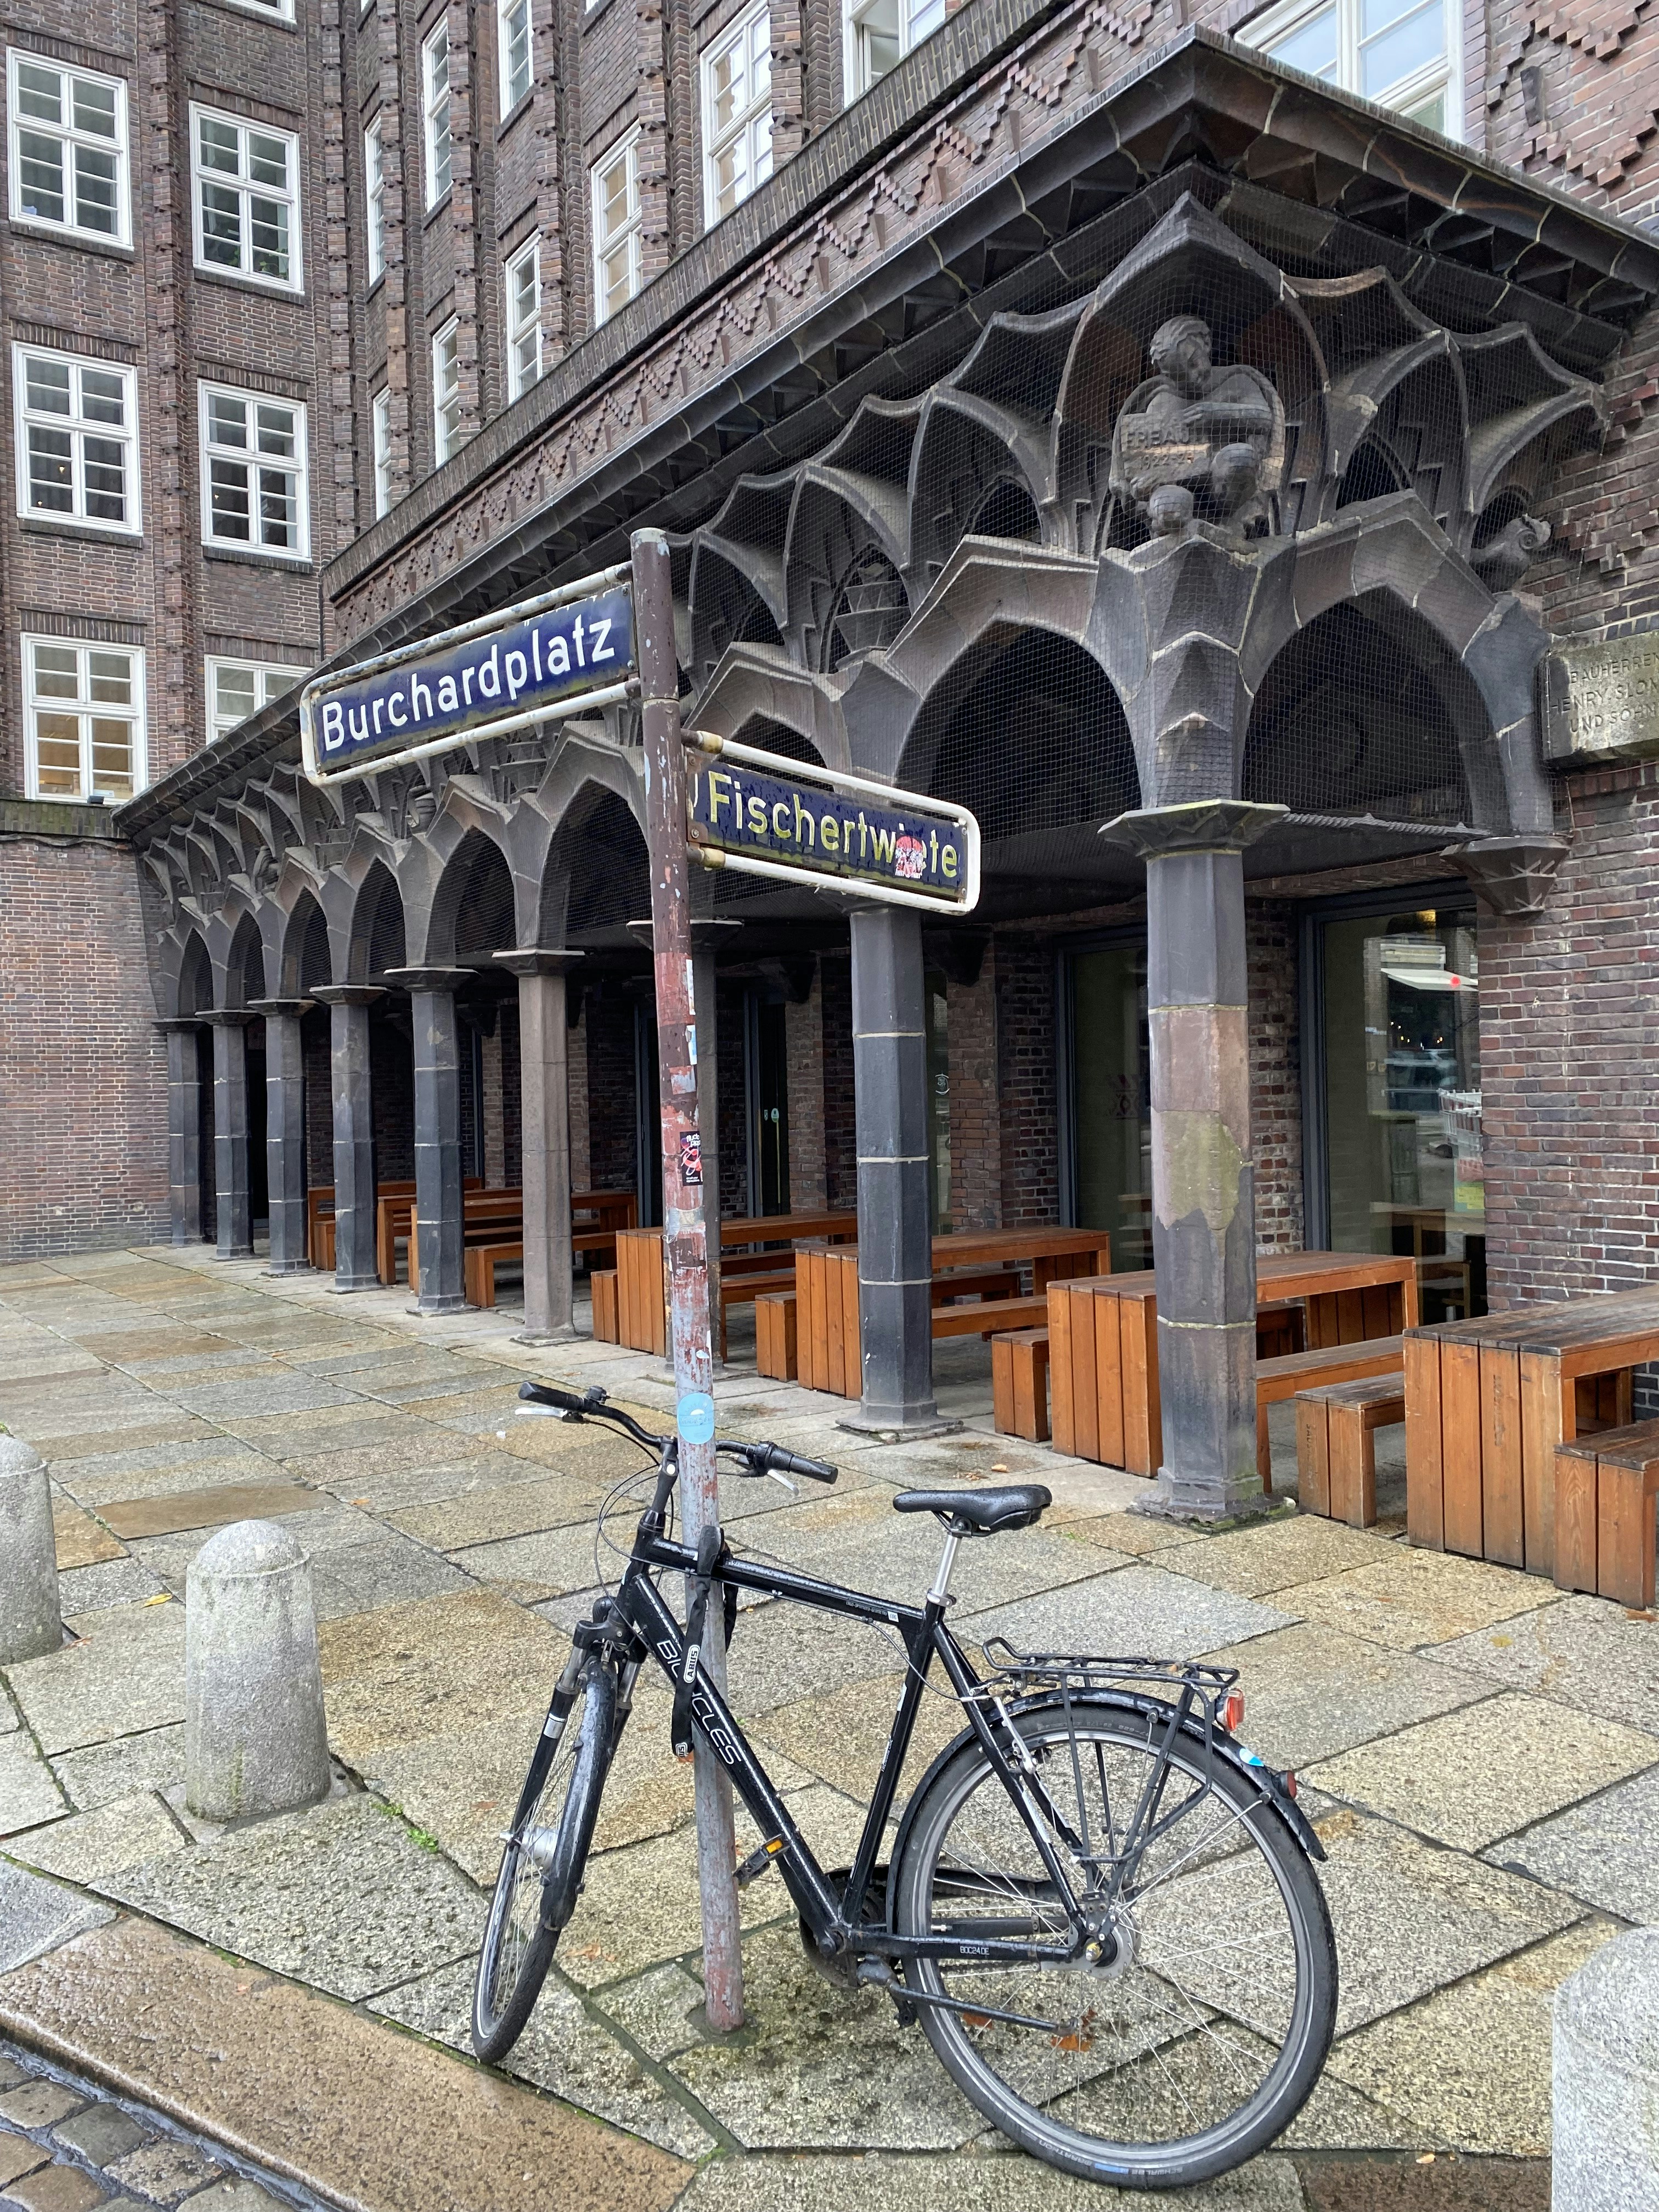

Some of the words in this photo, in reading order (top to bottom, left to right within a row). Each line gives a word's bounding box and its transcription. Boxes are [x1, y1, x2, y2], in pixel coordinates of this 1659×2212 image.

[323, 614, 615, 751] Burchardplatz
[1570, 714, 1604, 733] UND
[708, 771, 957, 878] Fischertwte
[687, 1650, 698, 1678] ABUS
